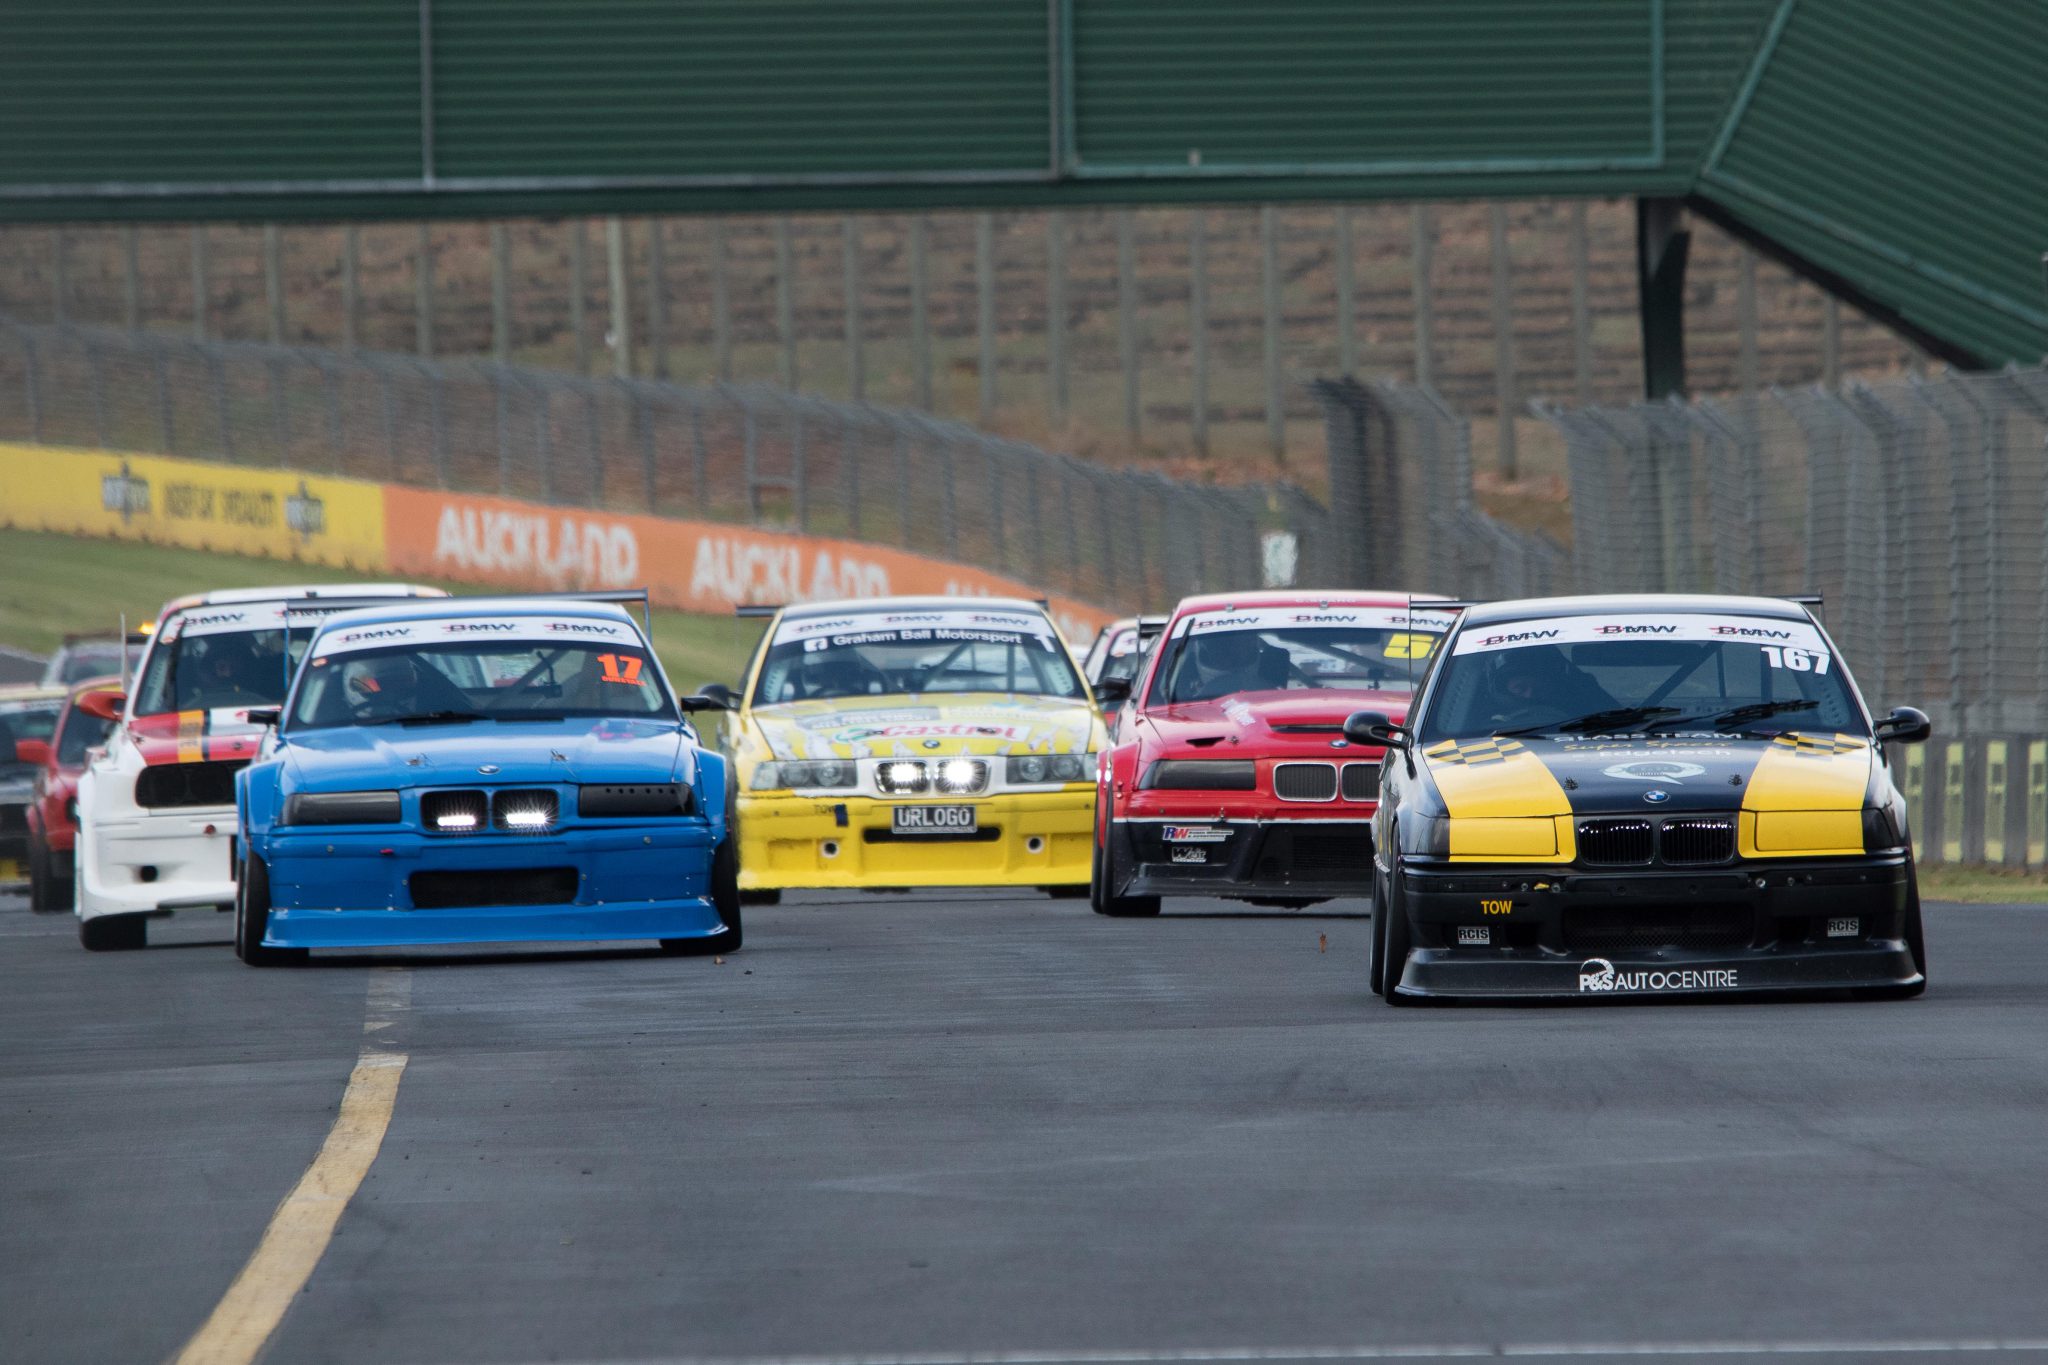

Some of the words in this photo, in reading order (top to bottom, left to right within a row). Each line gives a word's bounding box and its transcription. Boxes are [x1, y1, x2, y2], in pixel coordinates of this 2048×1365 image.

[447, 622, 516, 632] BMW
[551, 622, 618, 635] BMW
[833, 630, 897, 646] Graham
[900, 629, 932, 640] Ball
[935, 629, 1022, 645] Motorsport
[1486, 629, 1560, 646] BMW
[1602, 625, 1678, 635] BMW
[1718, 626, 1792, 639] BMW
[1383, 633, 1441, 660] 5
[597, 653, 643, 679] 17
[1761, 646, 1830, 675] 167
[1481, 901, 1512, 915] TOW
[1458, 929, 1489, 940] RCIS
[1828, 920, 1858, 931] RCIS
[1615, 970, 1738, 990] AUTOCENTRE
